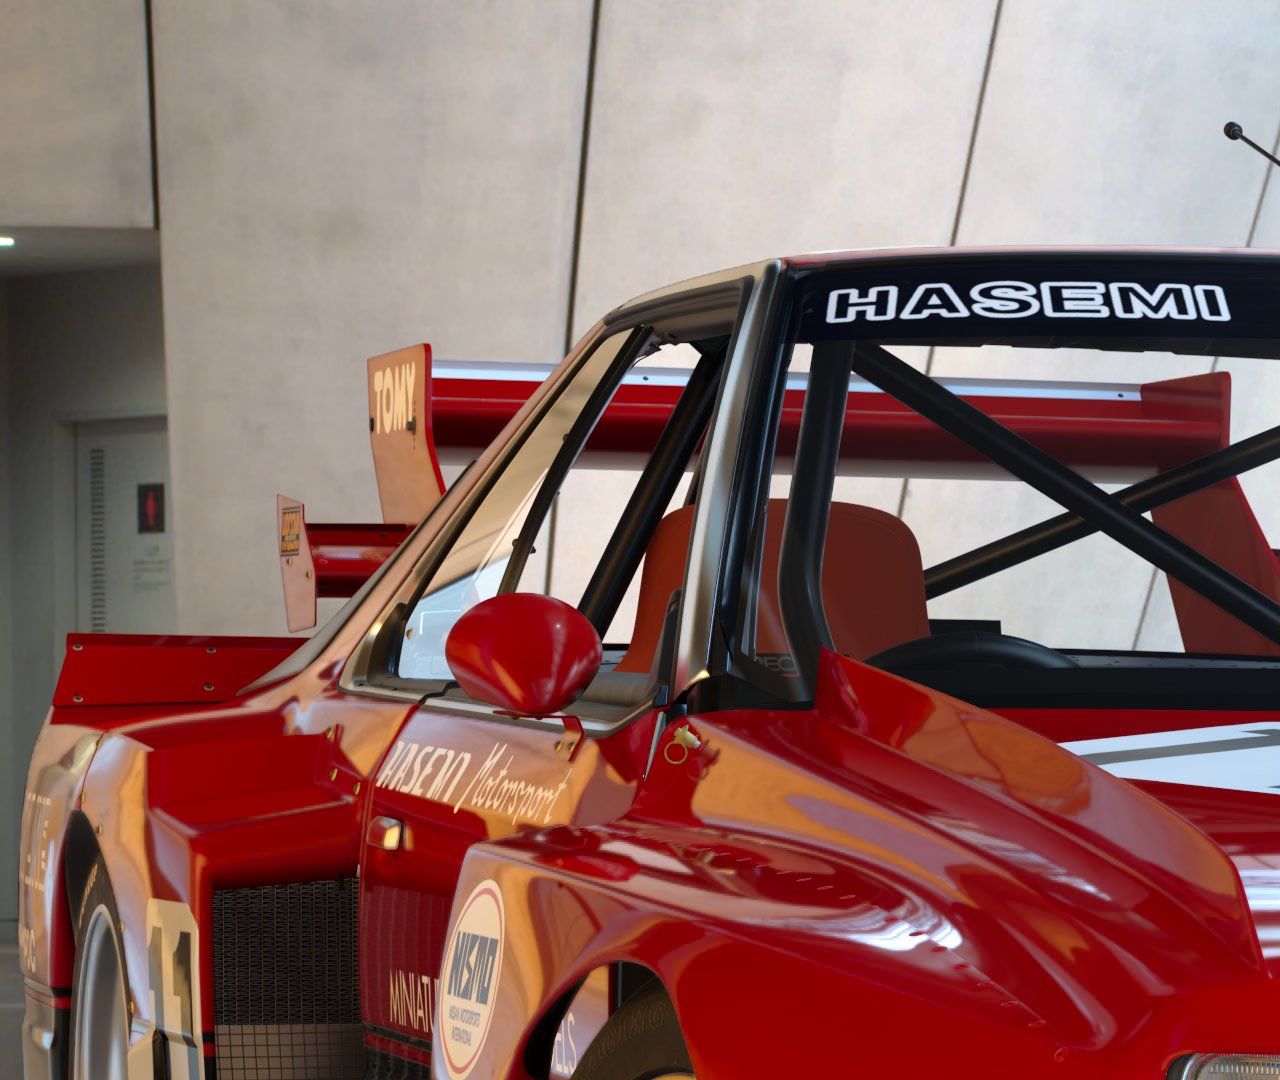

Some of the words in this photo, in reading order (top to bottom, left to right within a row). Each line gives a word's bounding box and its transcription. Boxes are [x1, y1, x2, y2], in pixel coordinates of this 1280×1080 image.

[826, 281, 1231, 324] HASEMI
[374, 361, 416, 435] TOMY
[376, 741, 472, 803] HASEMI
[454, 742, 573, 825] Motorsport
[390, 968, 440, 1034] MINIATU
[447, 930, 499, 1006] NISMO
[551, 1012, 577, 1075] ELS
